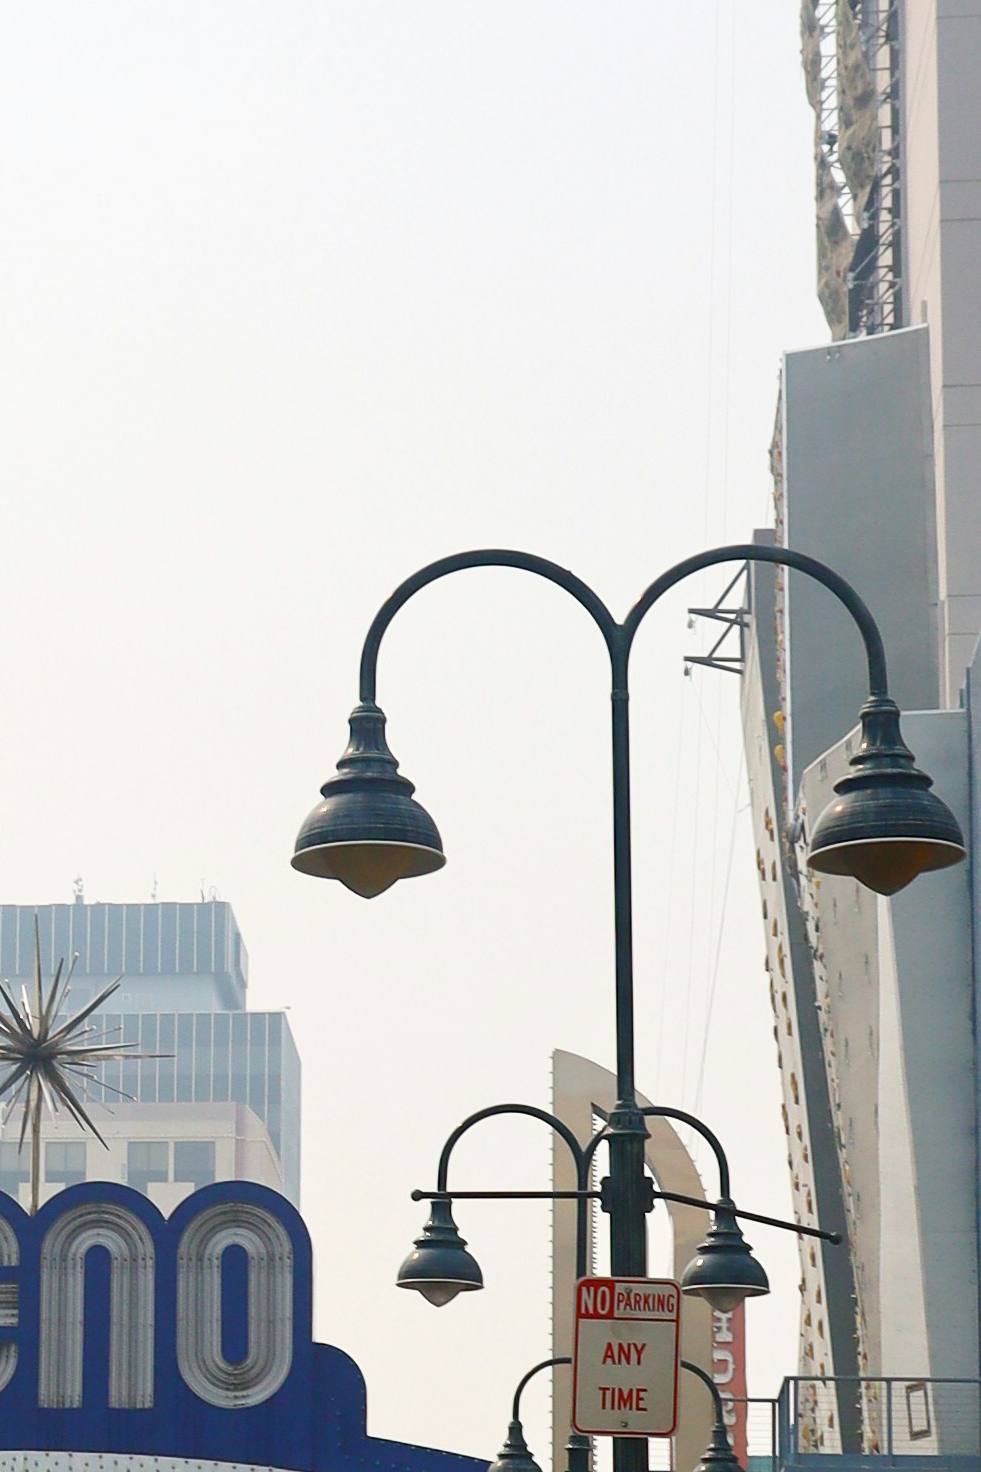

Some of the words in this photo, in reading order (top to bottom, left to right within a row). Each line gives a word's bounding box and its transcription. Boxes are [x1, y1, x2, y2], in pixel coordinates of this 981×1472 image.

[581, 1286, 611, 1315] NO
[617, 1290, 676, 1314] PARKING
[602, 1341, 647, 1366] ANY
[598, 1386, 649, 1412] TIME
